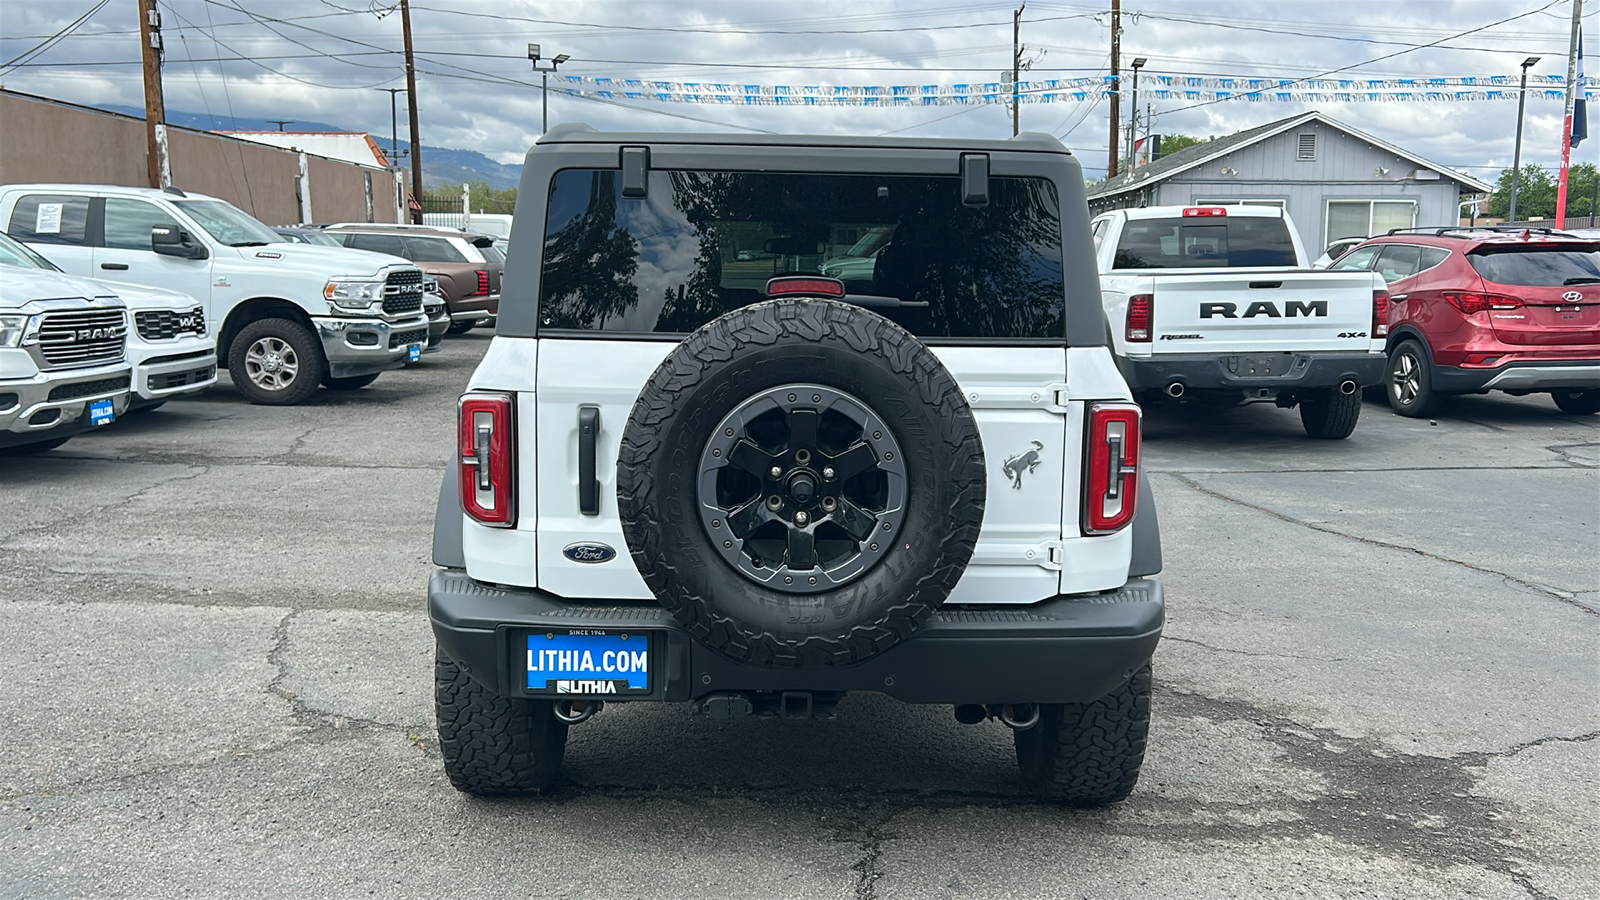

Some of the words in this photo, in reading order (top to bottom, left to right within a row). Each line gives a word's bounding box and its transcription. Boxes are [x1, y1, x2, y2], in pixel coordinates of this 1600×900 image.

[1199, 300, 1328, 319] RAM
[77, 325, 117, 341] RAM
[574, 546, 603, 560] Ford
[527, 649, 647, 672] LITHIA.COM
[570, 680, 617, 694] LITHIA
